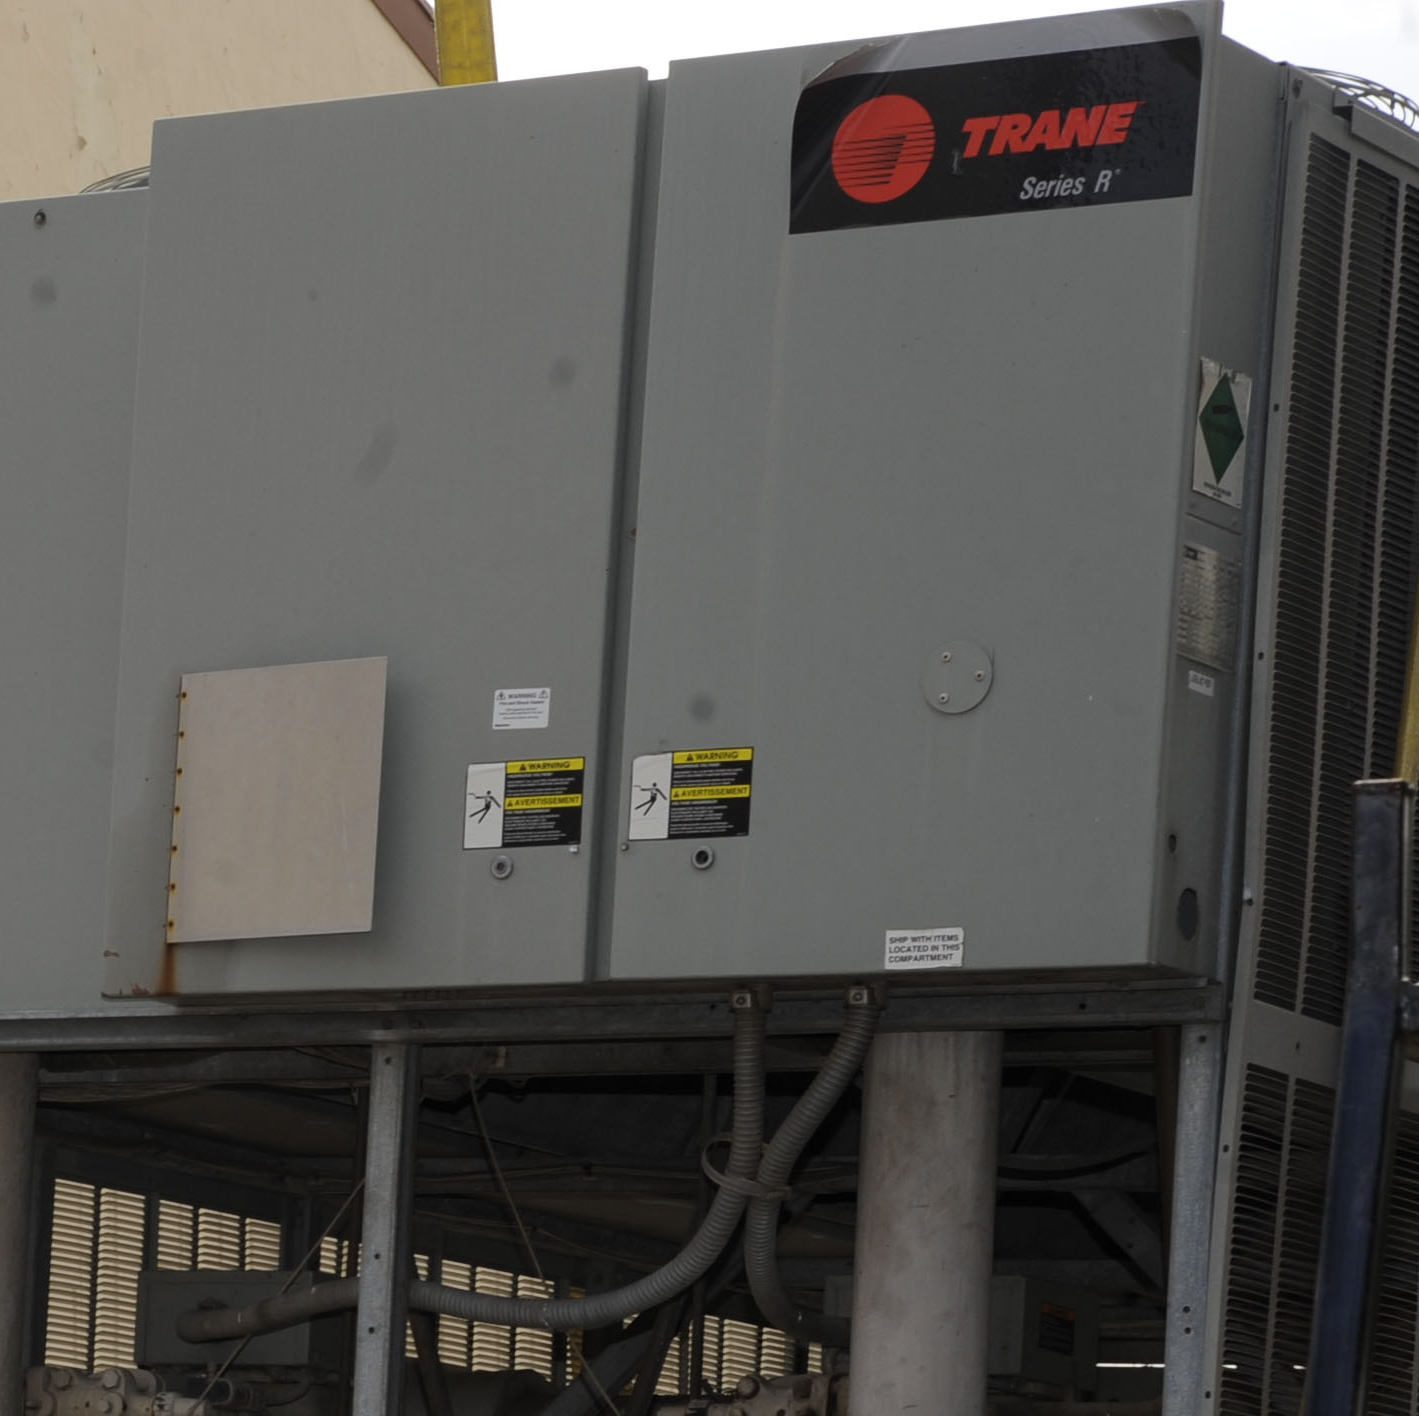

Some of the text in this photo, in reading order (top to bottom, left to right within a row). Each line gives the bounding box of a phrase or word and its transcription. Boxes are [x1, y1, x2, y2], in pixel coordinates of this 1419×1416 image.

[962, 101, 1140, 158] TRANE
[1019, 174, 1085, 200] Series
[696, 751, 739, 760] WARNING
[528, 761, 571, 770] WARNING
[910, 935, 932, 943] WITH
[933, 934, 960, 943] ITEMS
[888, 943, 960, 954] LOCATED IN THIS
[888, 953, 954, 963] COMPARTMENT
